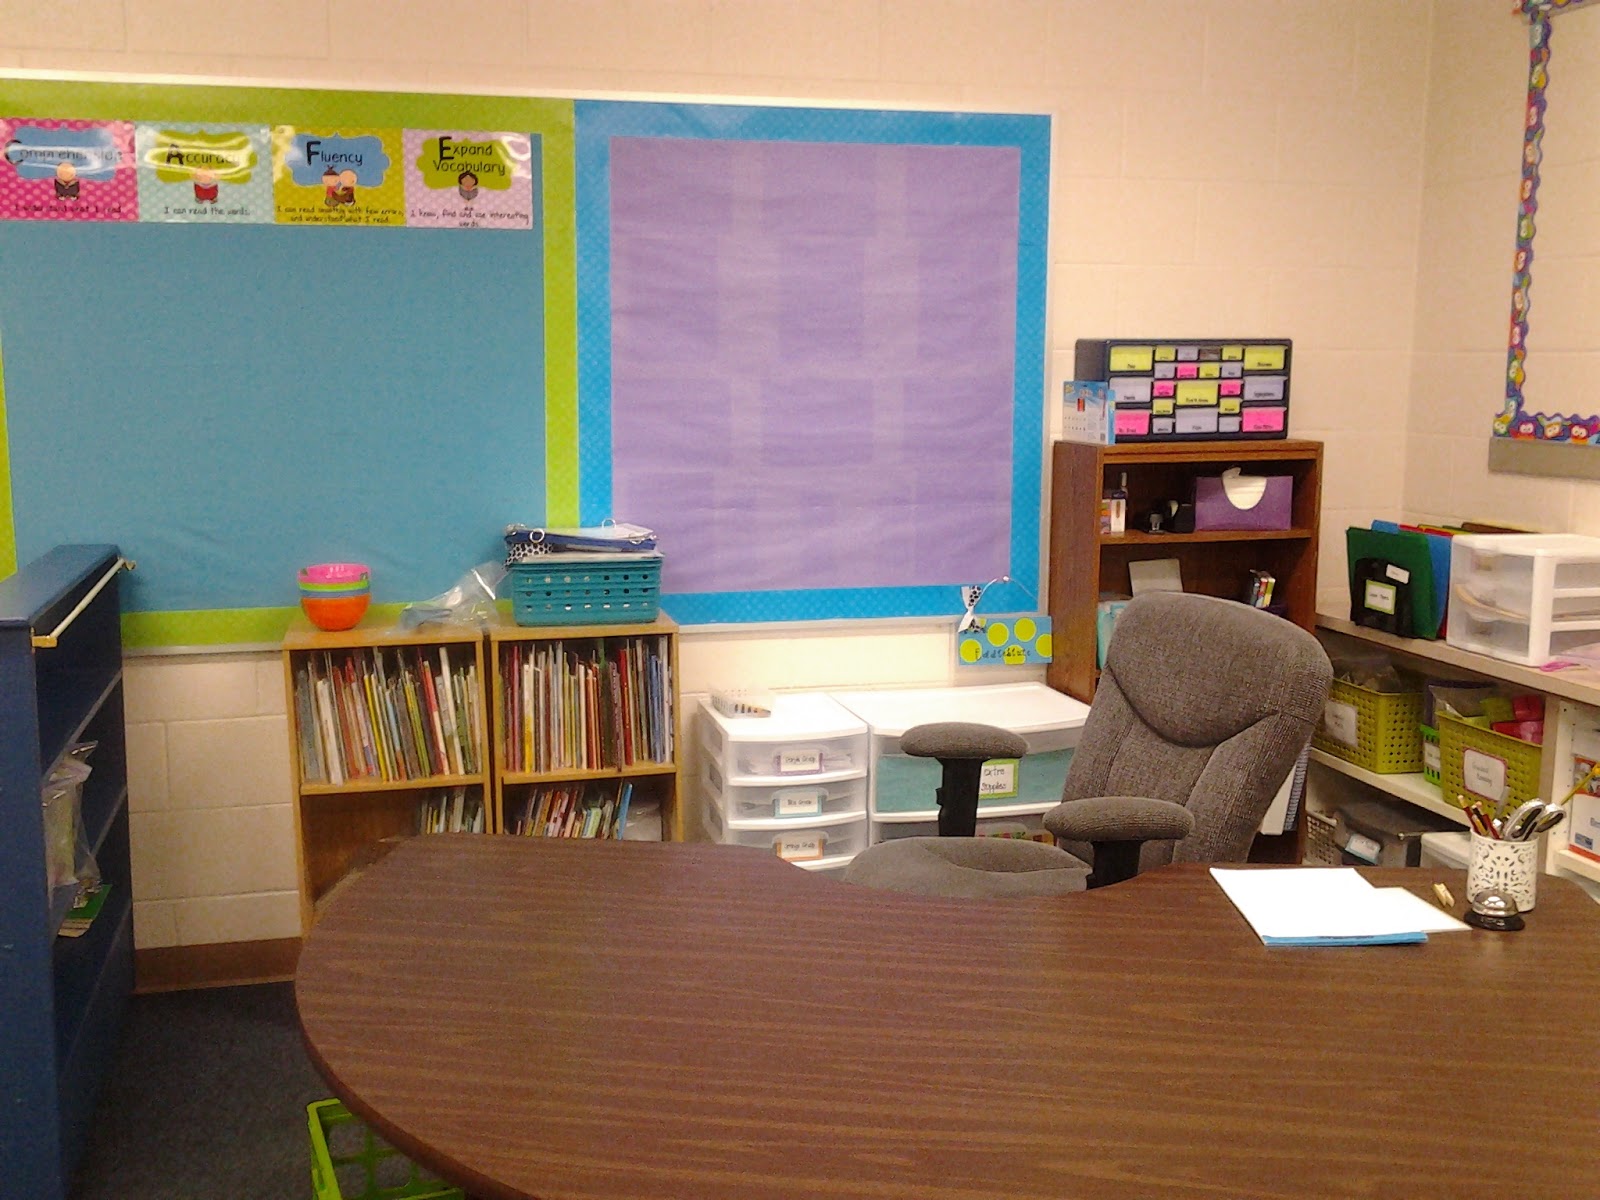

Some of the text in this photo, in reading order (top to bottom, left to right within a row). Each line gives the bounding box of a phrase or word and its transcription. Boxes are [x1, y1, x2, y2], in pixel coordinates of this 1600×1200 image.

[306, 140, 363, 167] Fluency
[438, 136, 493, 161] Expand
[432, 159, 506, 177] Vocabulary
[164, 206, 170, 215] I
[189, 207, 208, 216] read
